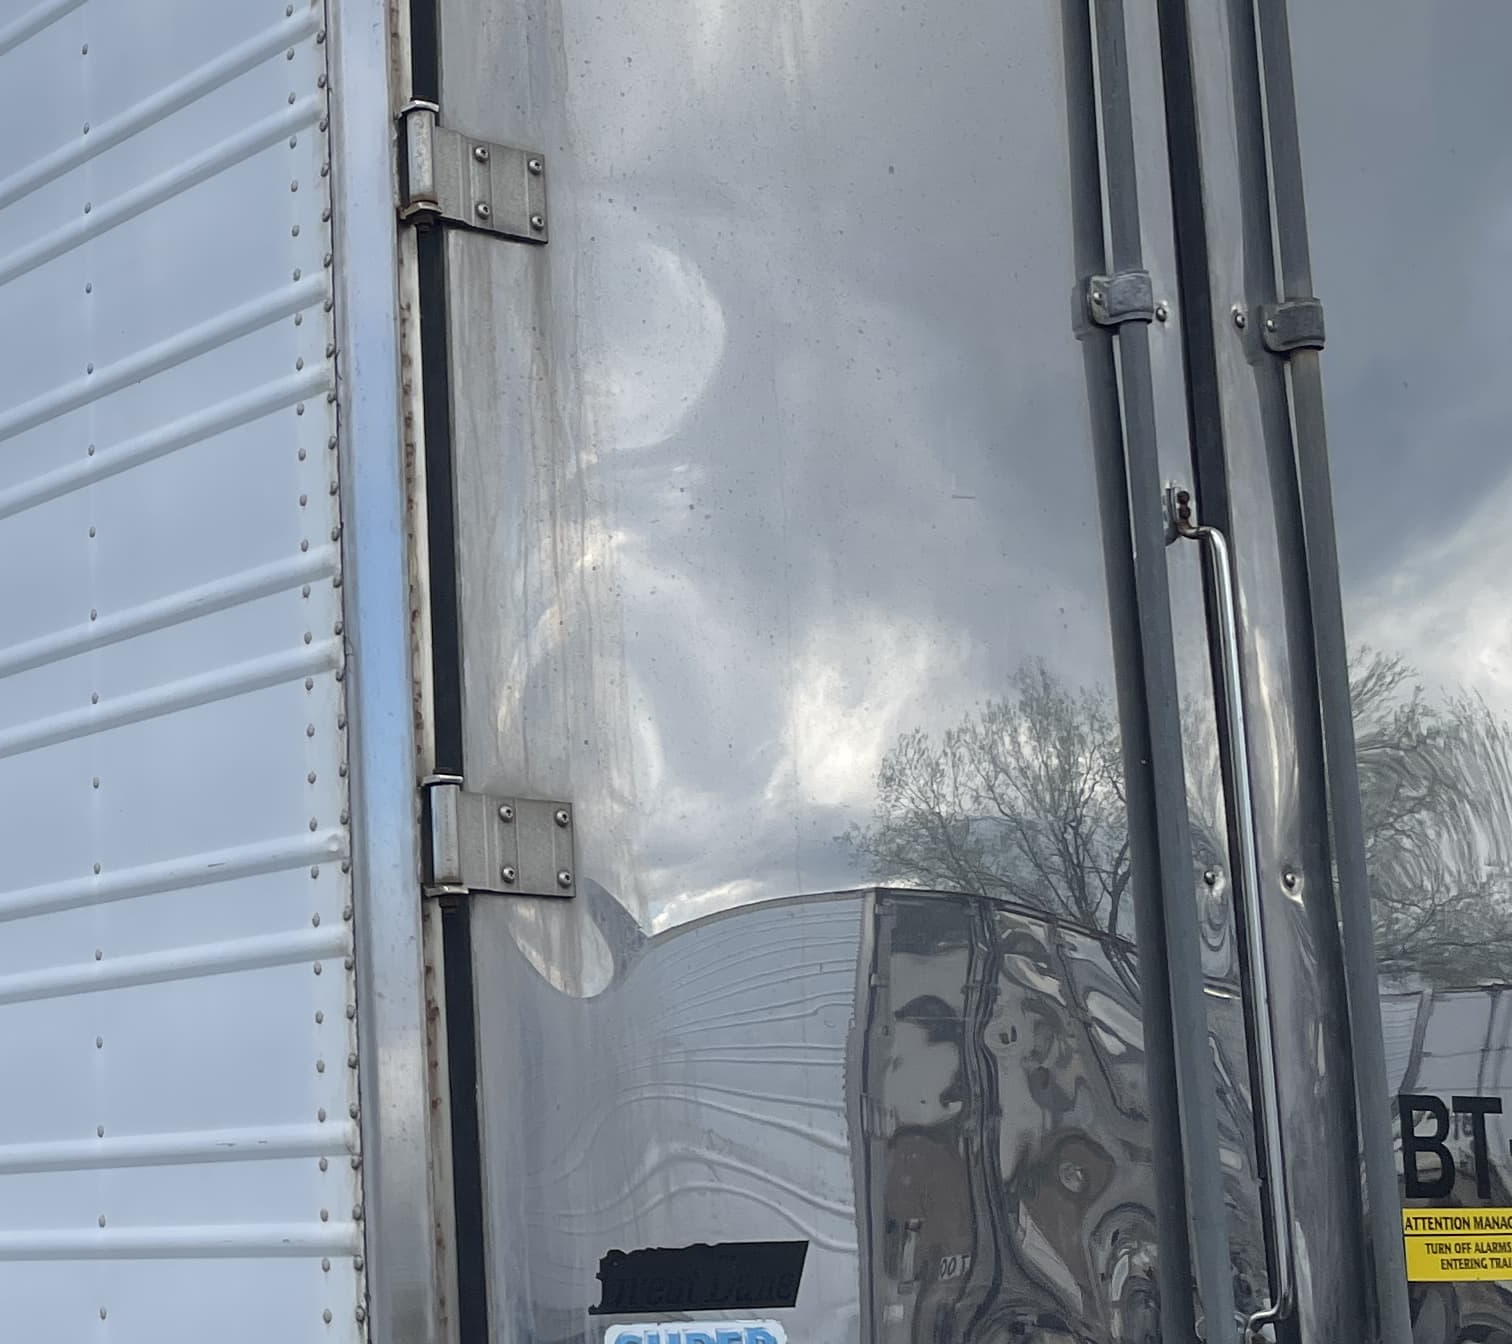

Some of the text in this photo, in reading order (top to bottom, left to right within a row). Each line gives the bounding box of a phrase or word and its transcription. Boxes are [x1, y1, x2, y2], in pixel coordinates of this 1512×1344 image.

[1398, 1094, 1512, 1199] BT
[1404, 1216, 1471, 1232] ATTENTION
[1424, 1241, 1512, 1255] TURN OFF ALARMS
[1440, 1257, 1488, 1270] ENTERING
